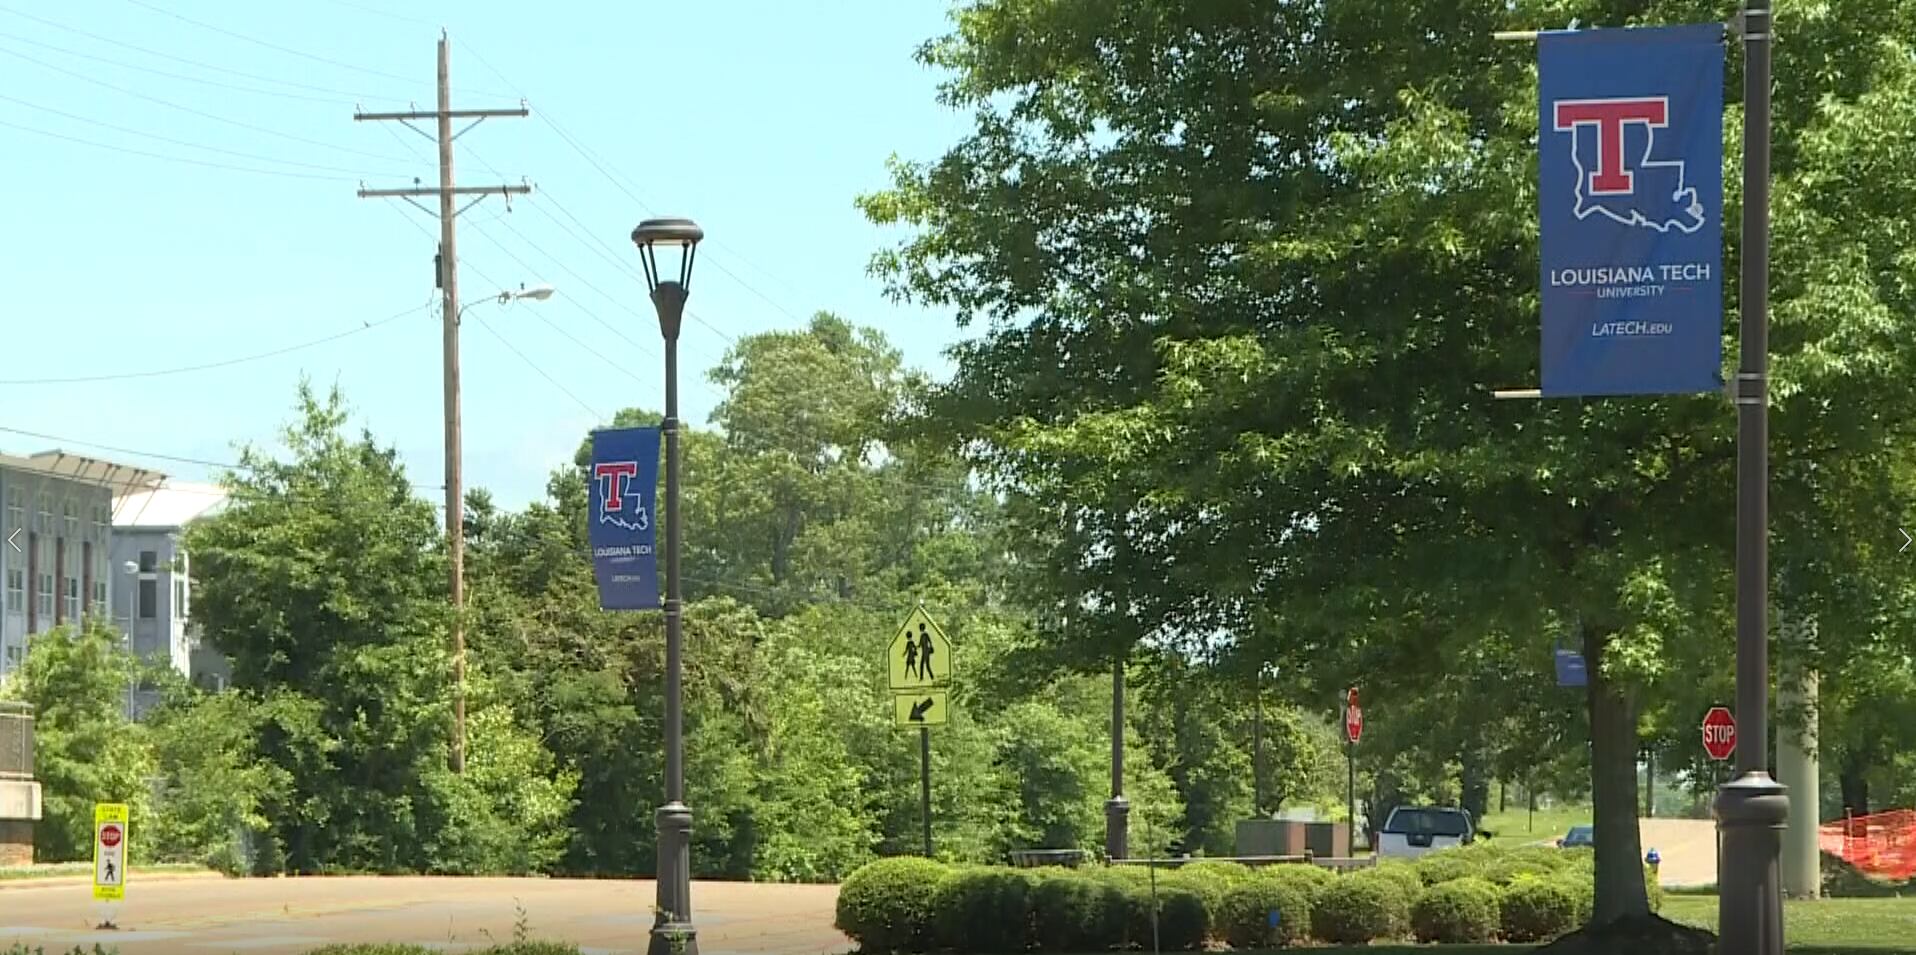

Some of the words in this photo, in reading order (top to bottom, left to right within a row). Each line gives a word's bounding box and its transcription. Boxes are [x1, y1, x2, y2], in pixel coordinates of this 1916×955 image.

[1554, 97, 1668, 195] T
[1551, 267, 1654, 286] LOUISIANA
[1660, 264, 1710, 281] TECH
[1597, 285, 1665, 298] UNIVERSITY
[1592, 321, 1672, 335] LATECH.EDU
[595, 461, 637, 511] T
[594, 546, 631, 557] LOUISIANA
[632, 545, 651, 554] TECH
[1705, 724, 1735, 744] STOP
